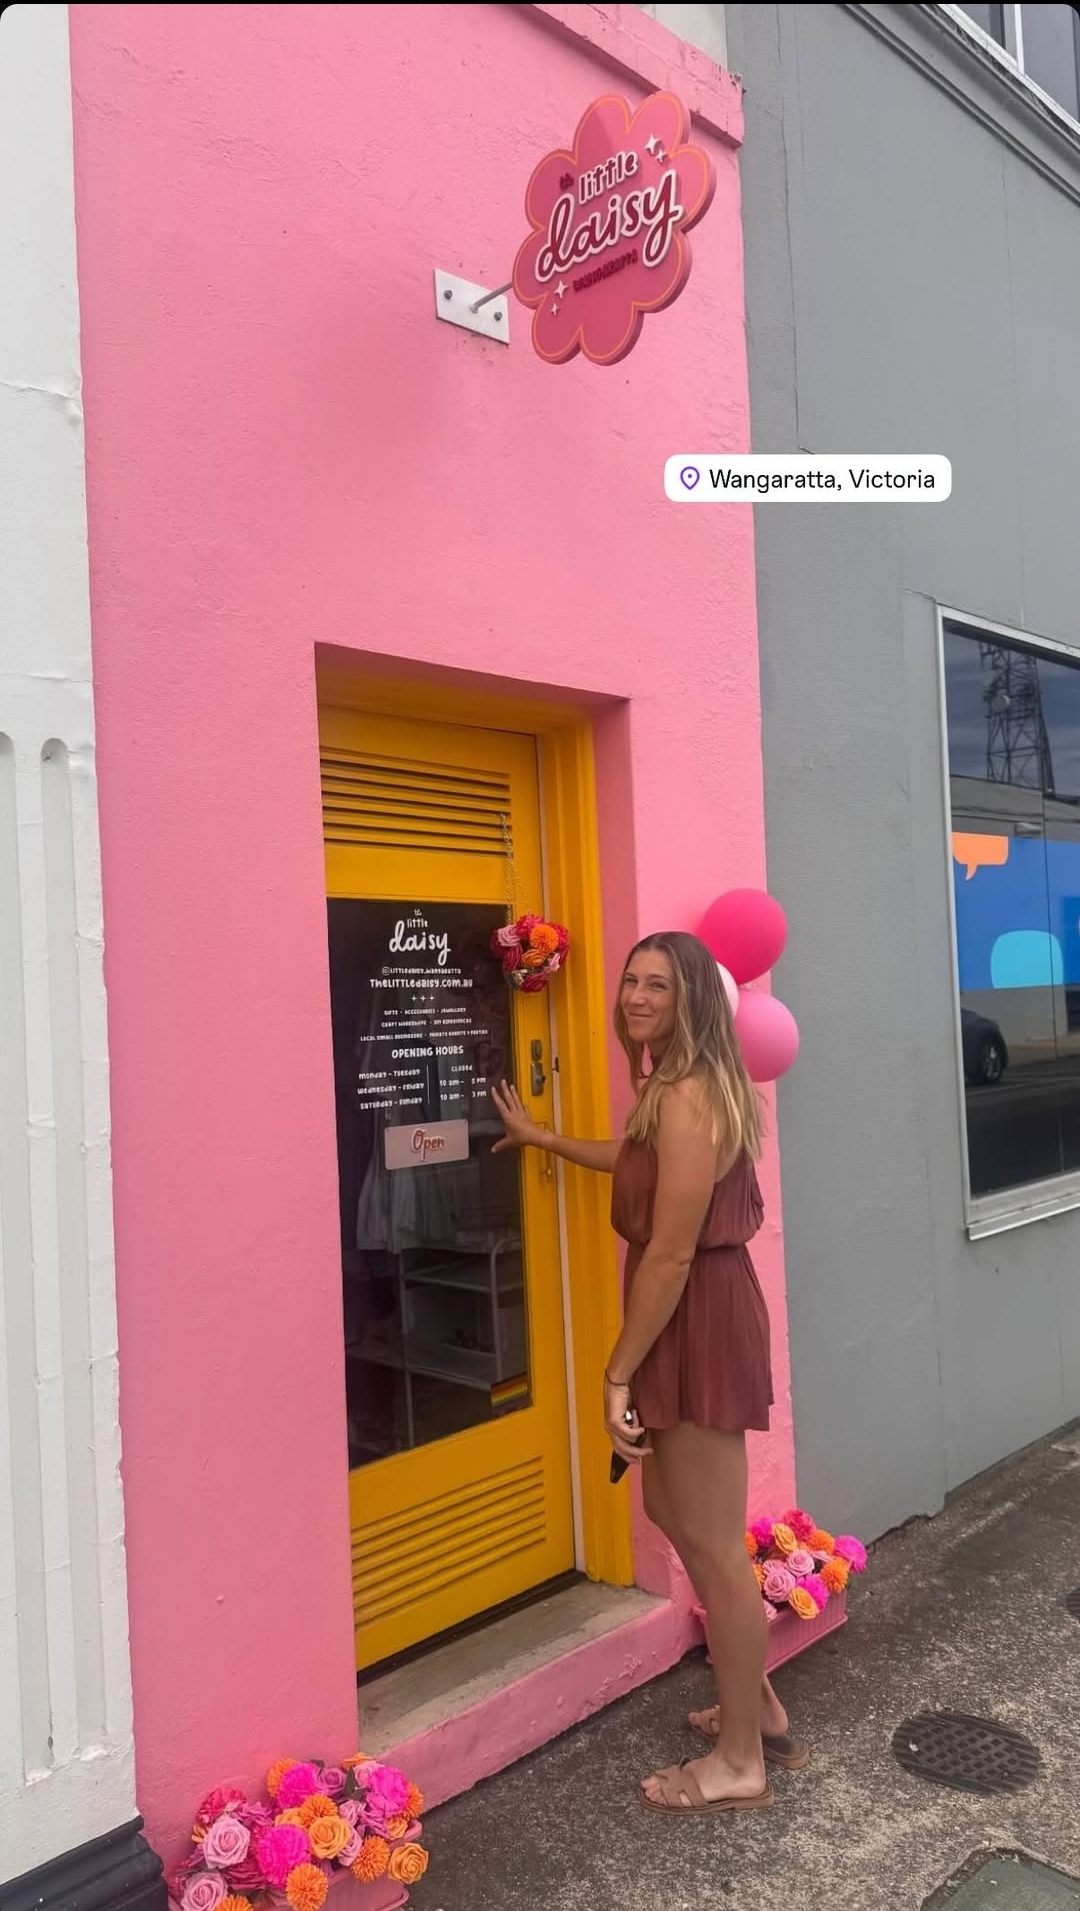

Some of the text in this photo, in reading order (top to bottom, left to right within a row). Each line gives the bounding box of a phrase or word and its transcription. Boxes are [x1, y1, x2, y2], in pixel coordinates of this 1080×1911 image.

[579, 152, 638, 204] little
[536, 169, 683, 282] daisy
[407, 918, 429, 928] little
[389, 920, 452, 966] daisy
[391, 1045, 464, 1059] OPENING HOURS
[412, 1128, 446, 1160] Open
